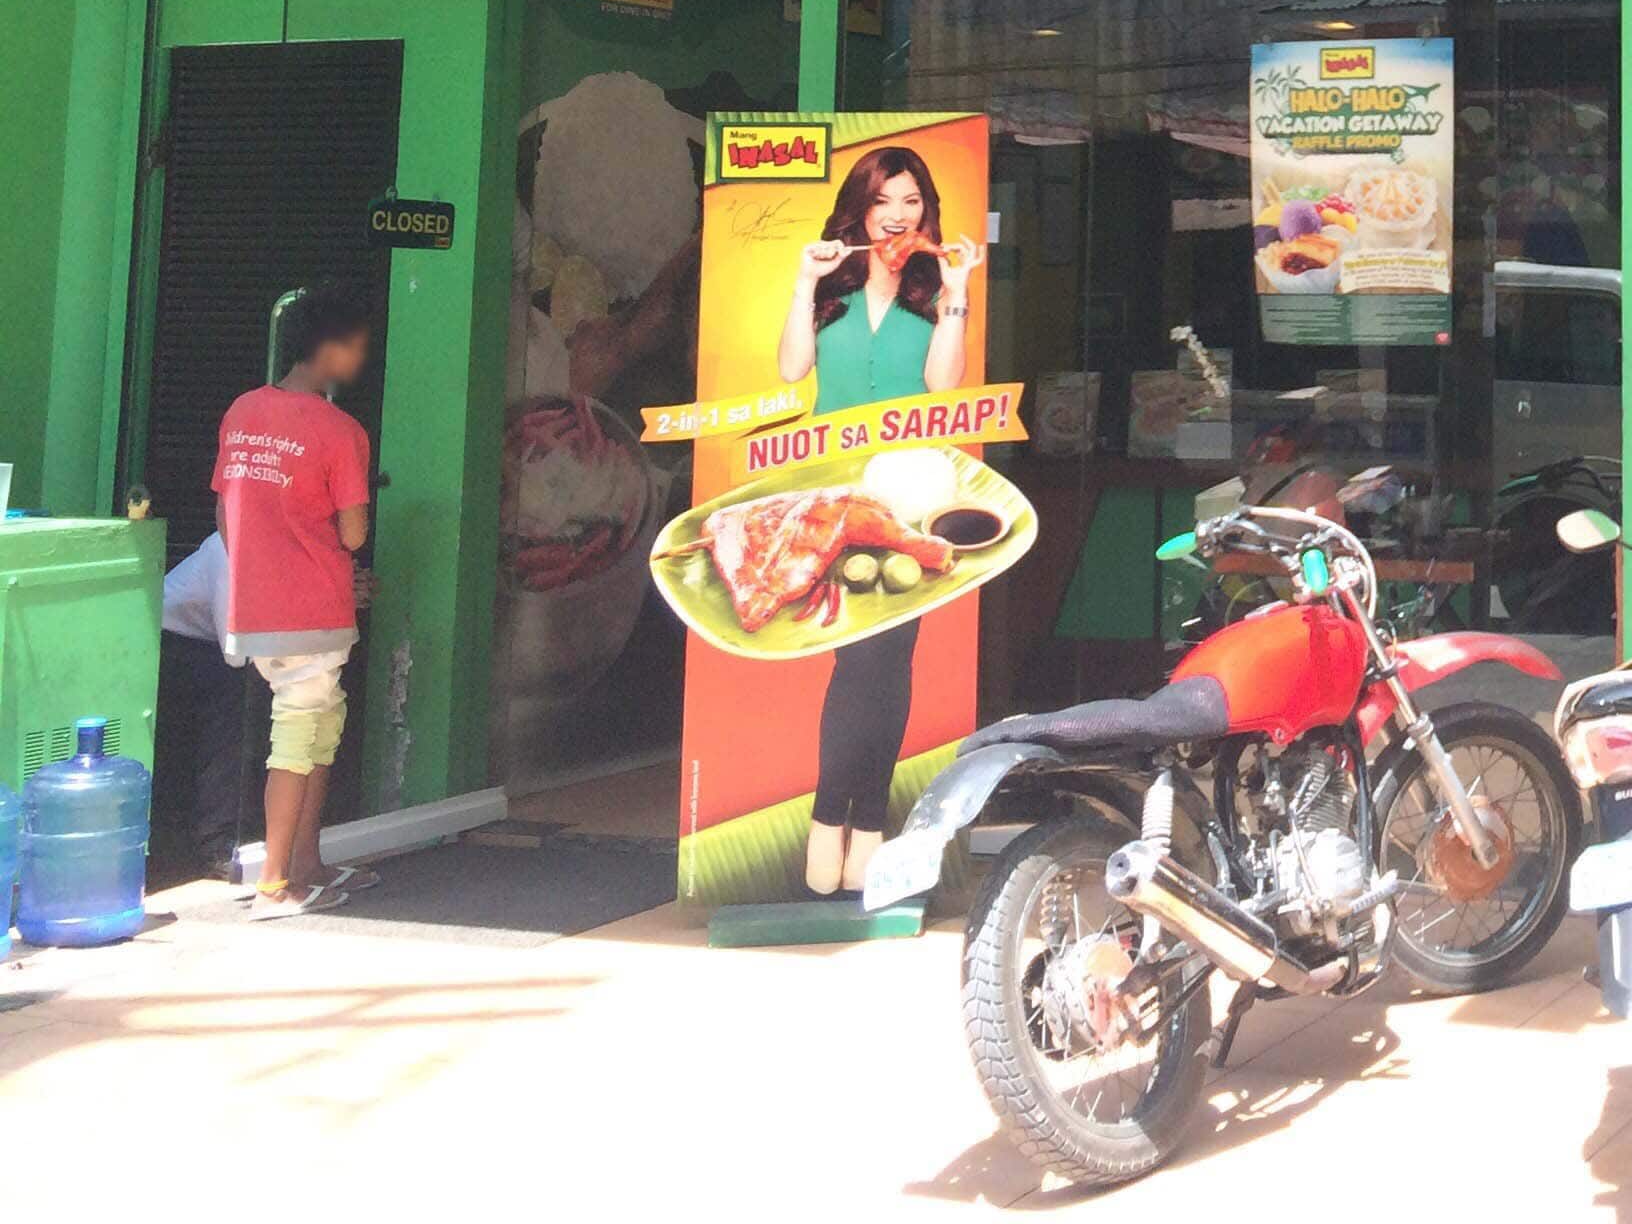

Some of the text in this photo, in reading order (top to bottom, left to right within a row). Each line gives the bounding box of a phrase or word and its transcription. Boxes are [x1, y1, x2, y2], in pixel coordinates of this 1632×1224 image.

[1290, 87, 1406, 113] HALO-HALO
[1257, 112, 1442, 134] VACATION GETAWAY
[729, 130, 757, 142] Mang
[1291, 135, 1401, 150] RAFFLE PROMO
[728, 135, 819, 169] INASAL
[372, 210, 449, 234] CLOSED
[656, 410, 720, 436] 2-in-1
[727, 405, 752, 424] sa
[748, 393, 1010, 472] NUOT SA SARAP!
